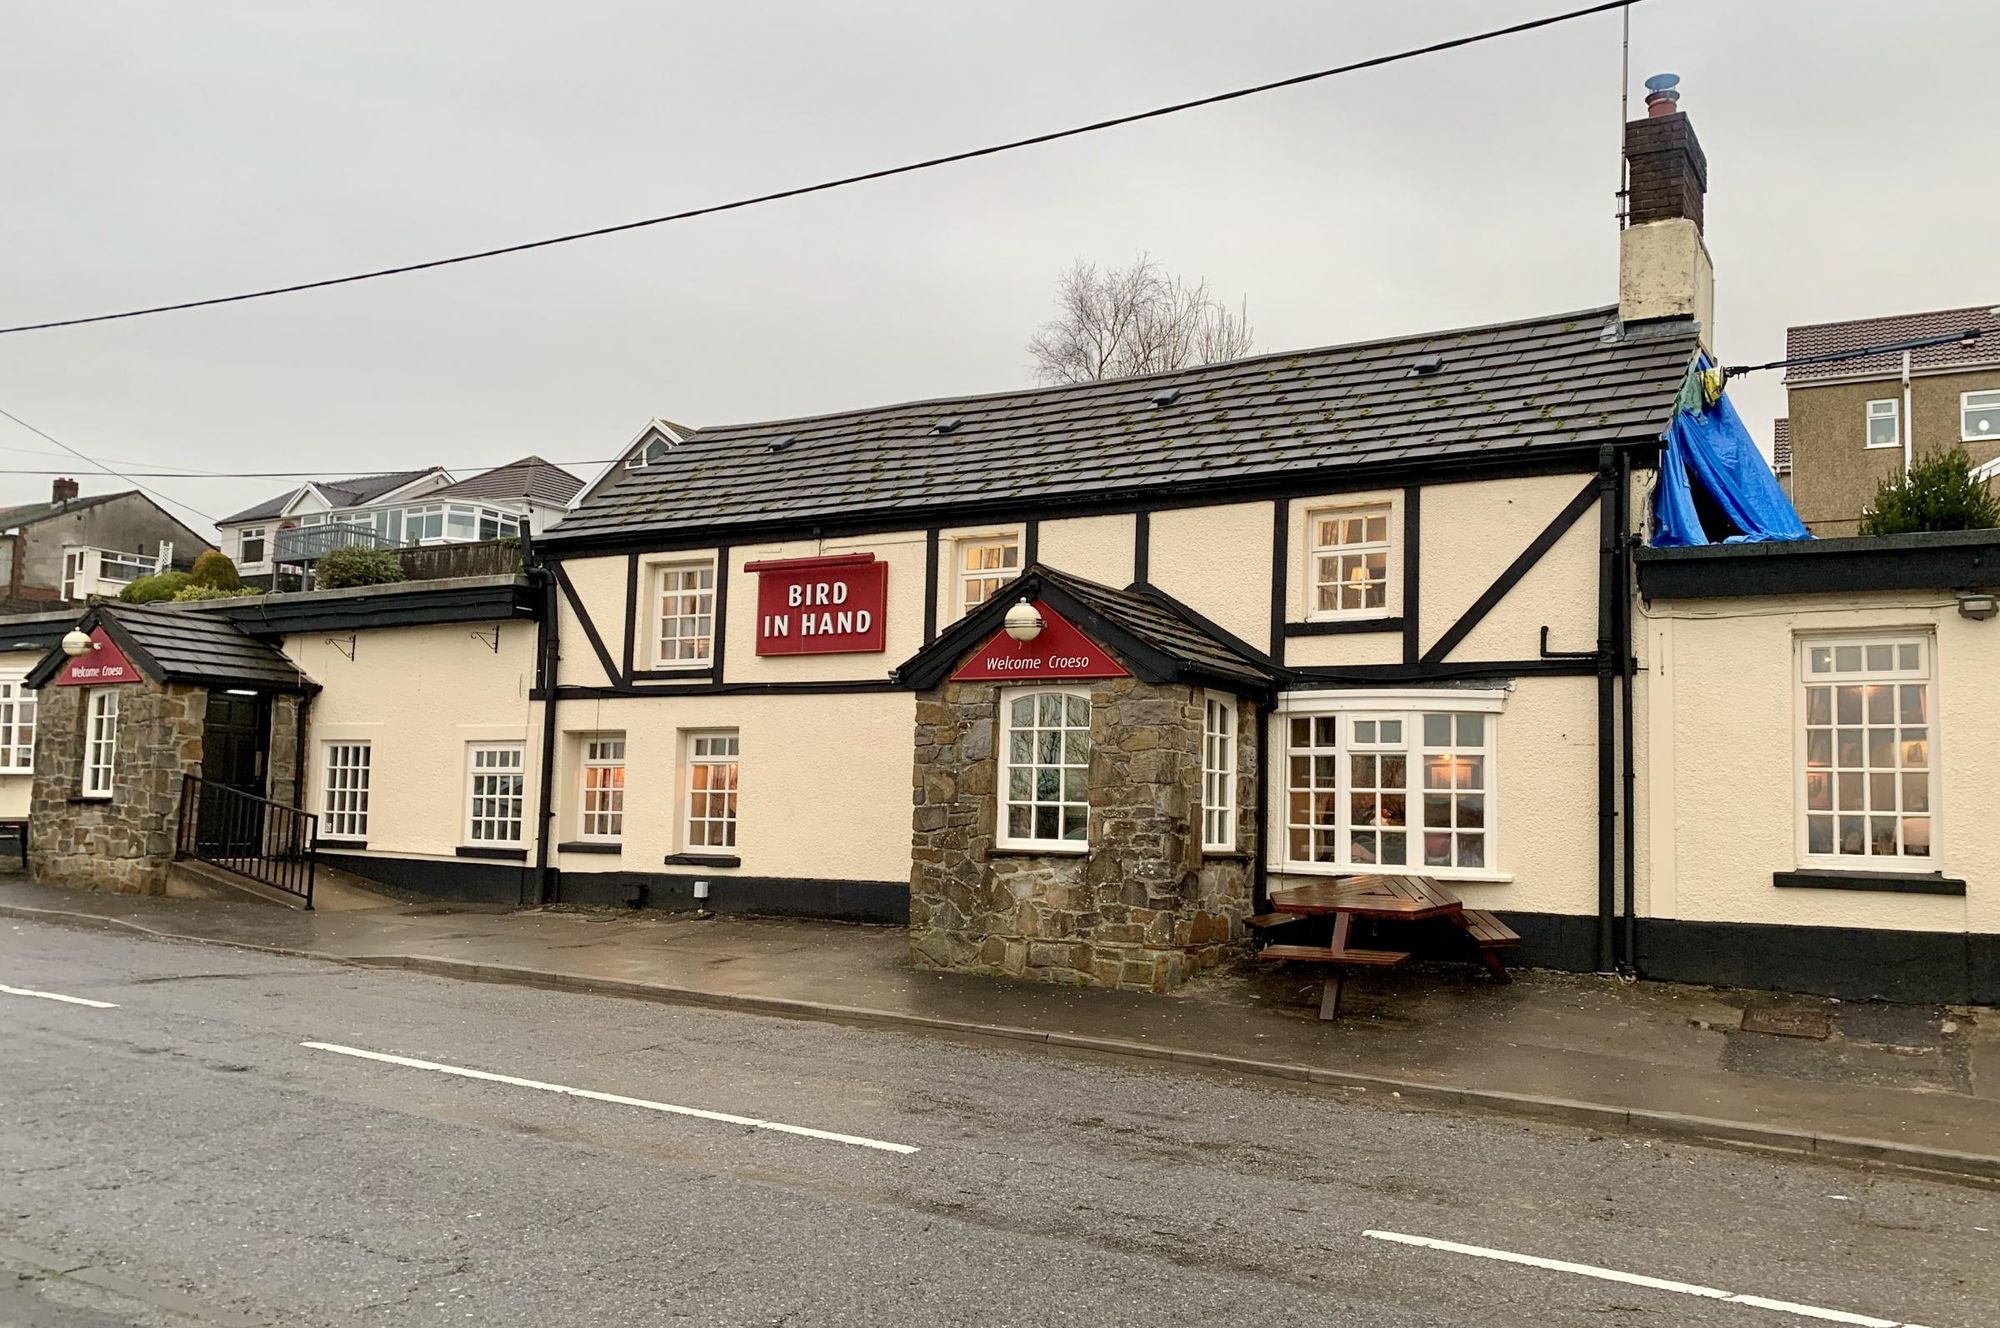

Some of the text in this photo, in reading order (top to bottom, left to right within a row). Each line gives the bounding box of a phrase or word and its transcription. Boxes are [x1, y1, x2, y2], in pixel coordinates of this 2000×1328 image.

[788, 581, 848, 607] BIRD
[764, 610, 872, 637] IN HAND
[71, 665, 123, 678] Welcome Croeso
[986, 655, 1089, 670] Welcome Croeso
